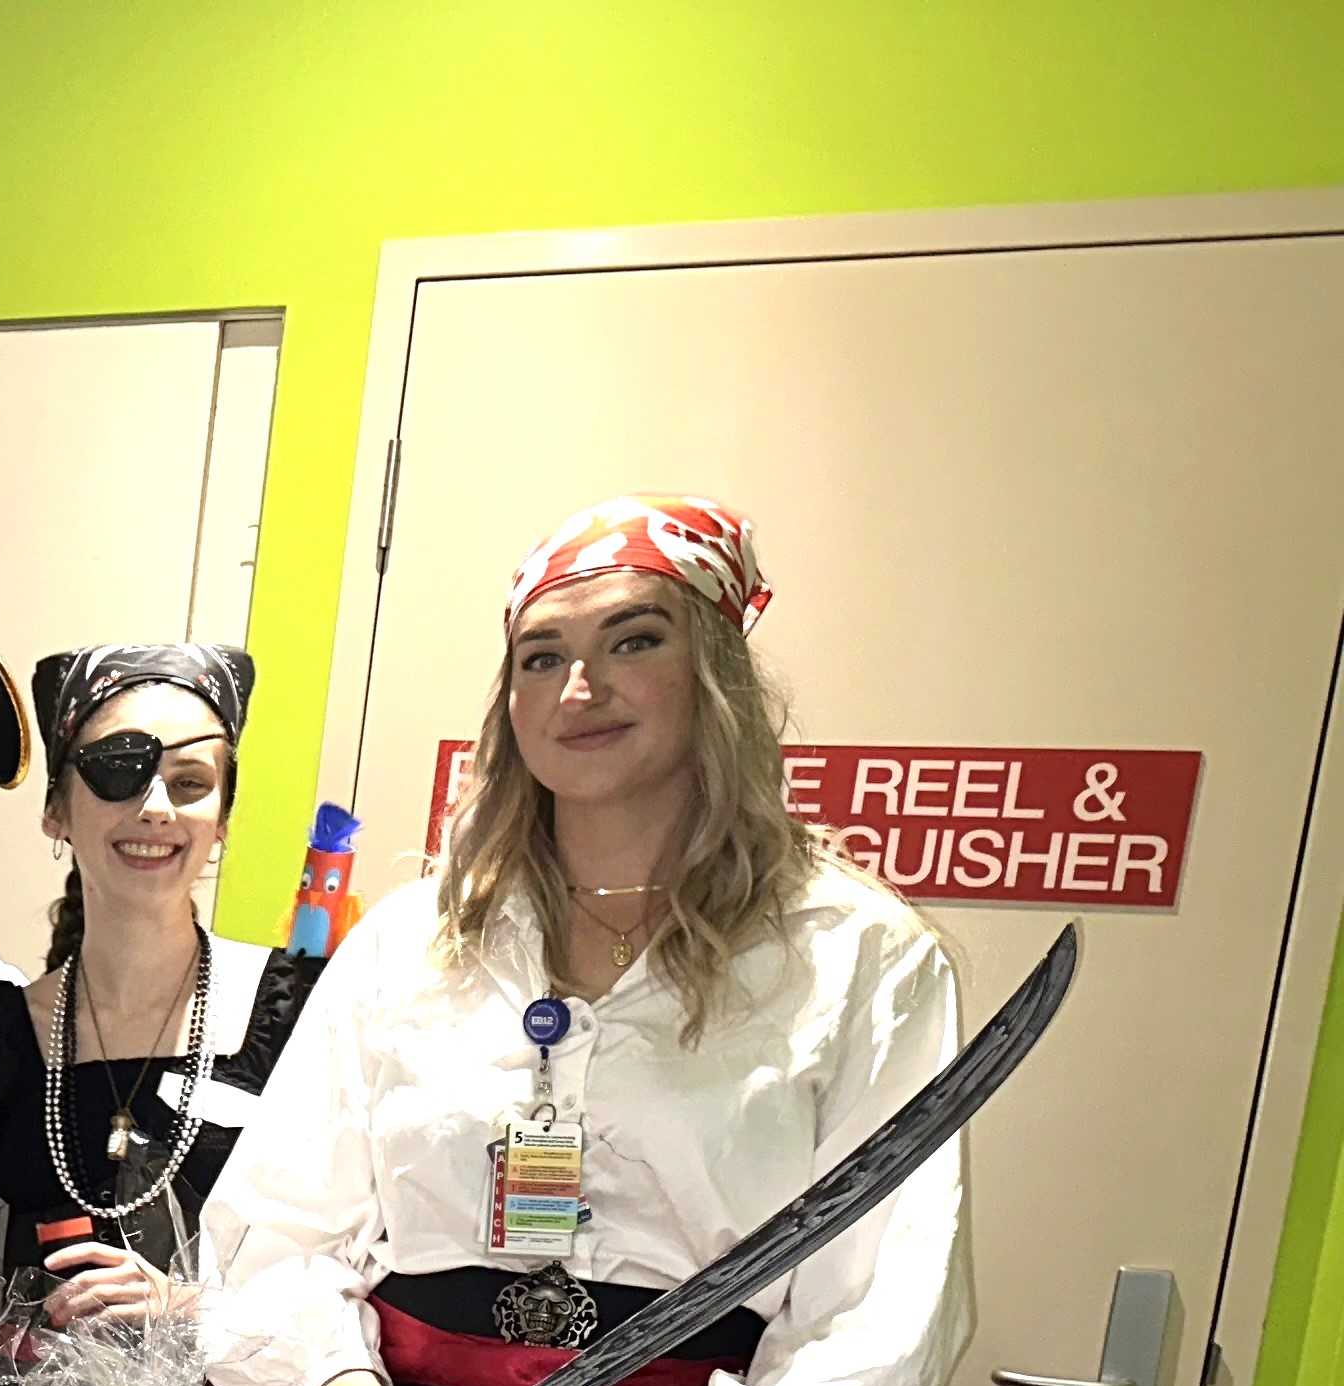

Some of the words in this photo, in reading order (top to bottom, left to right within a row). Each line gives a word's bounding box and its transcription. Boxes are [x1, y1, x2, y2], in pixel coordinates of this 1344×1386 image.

[849, 757, 1045, 820] REEL
[1072, 761, 1127, 823] &
[827, 825, 1170, 894] GUISHER
[514, 1131, 523, 1144] 5
